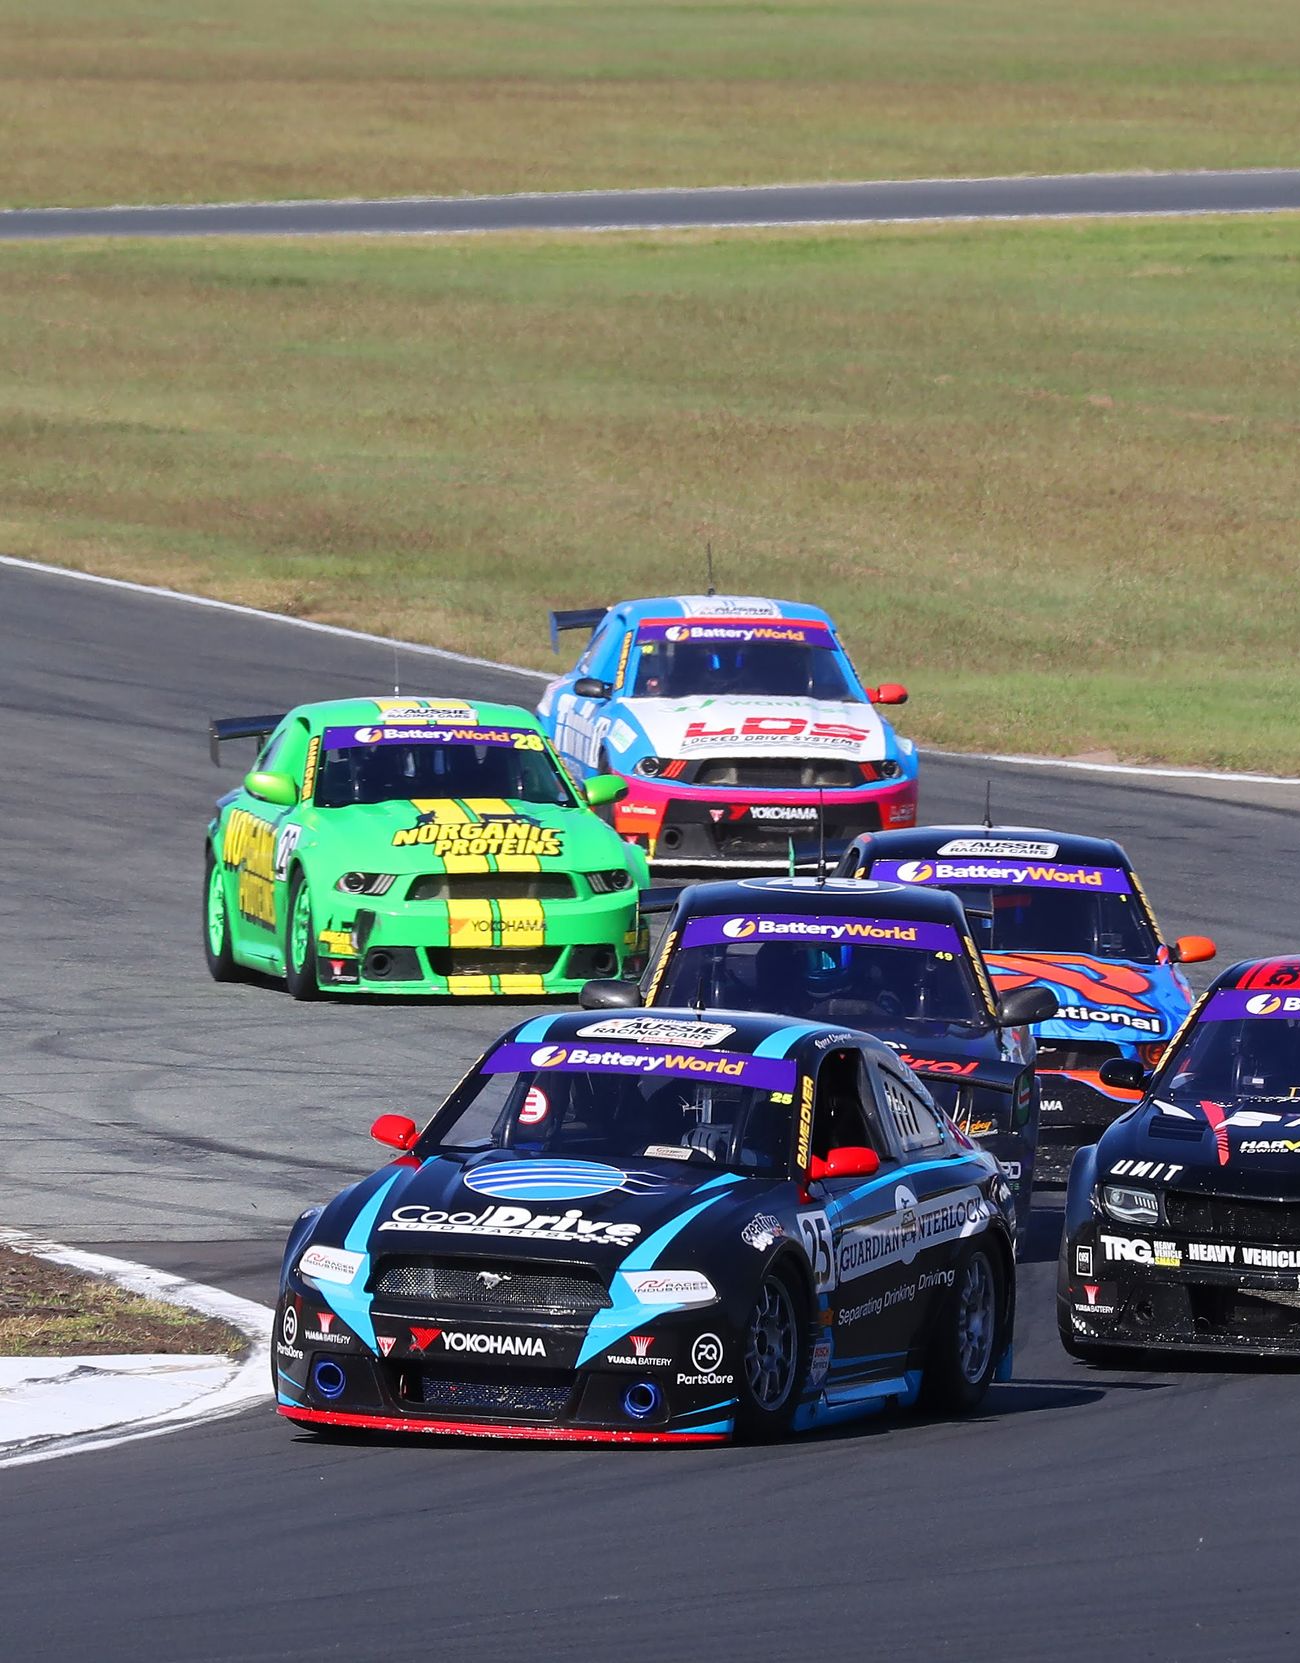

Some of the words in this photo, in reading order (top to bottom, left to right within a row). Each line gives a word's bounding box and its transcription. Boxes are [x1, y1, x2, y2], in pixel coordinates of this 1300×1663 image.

[691, 627, 805, 642] BatteryWorld
[384, 729, 510, 742] BatteryWorld
[684, 717, 870, 741] LDS
[511, 733, 545, 751] 28
[682, 735, 739, 747] LOCKED
[744, 734, 789, 742] DRIVE
[793, 736, 862, 749] SYSTEMS
[750, 806, 818, 820] YOKOHAMA
[391, 823, 562, 846] NORGANIC
[434, 838, 561, 856] PROTEINS
[949, 847, 1005, 855] RACING
[1008, 848, 1049, 856] CARS
[969, 841, 1049, 850] AUSSIE
[935, 865, 1103, 886] BatteryWorld
[472, 920, 548, 932] YOKOHAMA
[758, 920, 917, 941] BatteryWorld
[935, 951, 954, 961] 49
[593, 1027, 661, 1037] RACING
[665, 1031, 713, 1041] CARS
[621, 1022, 725, 1036] AUSSIE
[567, 1049, 744, 1076] BatteryWorld
[770, 1092, 793, 1105] 25
[391, 1205, 642, 1238] CoolDrive
[386, 1222, 456, 1231] AUTO
[471, 1227, 561, 1238] PARTS
[801, 1218, 831, 1286] 25
[840, 1230, 900, 1272] GUARDIAN
[1153, 1240, 1177, 1250] HEAVY
[1154, 1249, 1183, 1260] VEHICLE
[1188, 1243, 1237, 1263] HEAVY
[1154, 1257, 1181, 1267] SMASH
[838, 1297, 883, 1325] Separating
[884, 1283, 916, 1308] Drinking
[918, 1268, 956, 1291] Driving
[1075, 1303, 1091, 1313] YUASA
[1090, 1304, 1114, 1314] BATTERY
[305, 1330, 323, 1340] YUASA
[441, 1331, 546, 1357] YOKOHAMA
[607, 1355, 637, 1365] YUASA
[638, 1357, 672, 1366] BATTERY
